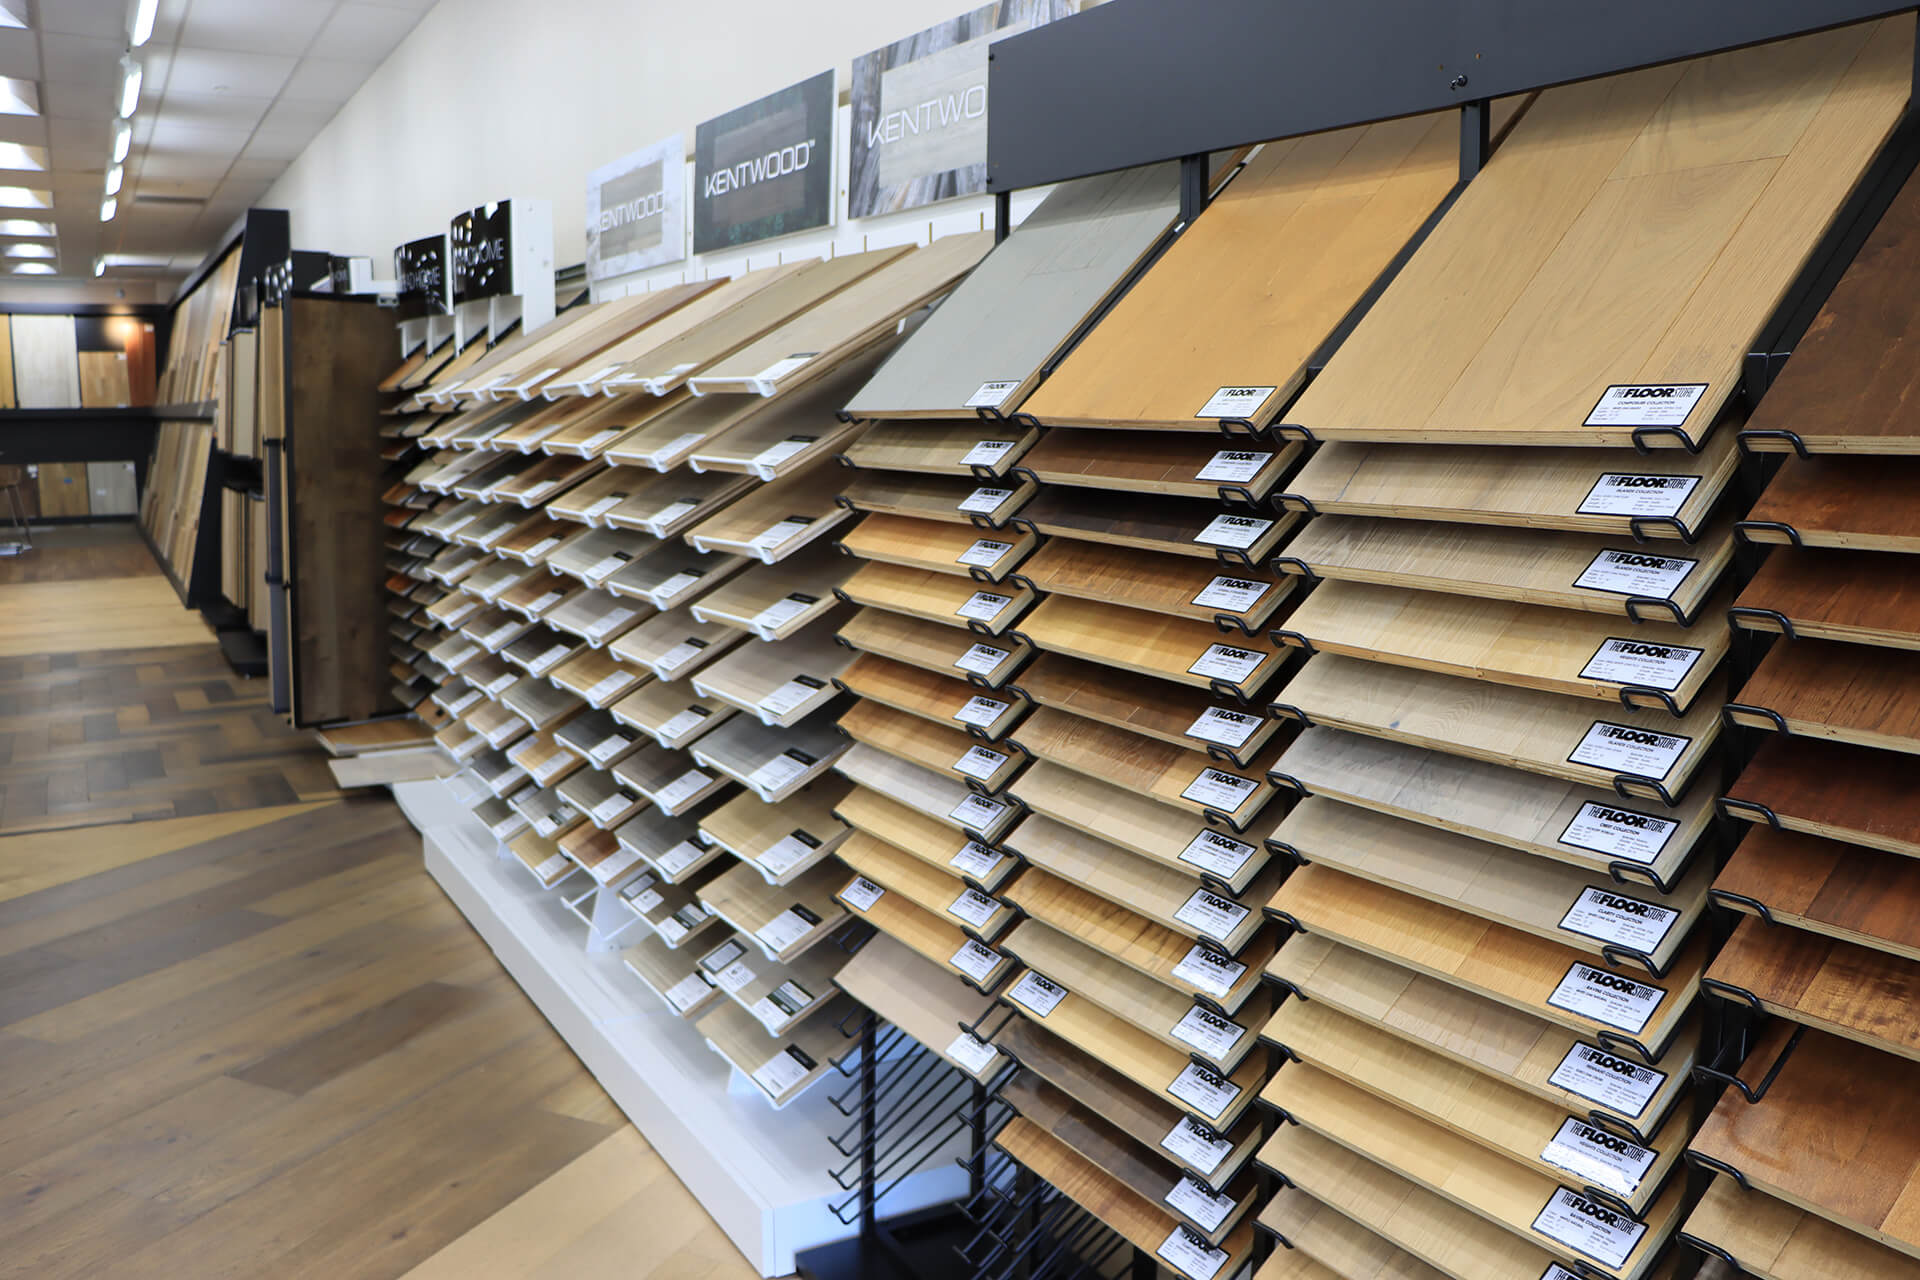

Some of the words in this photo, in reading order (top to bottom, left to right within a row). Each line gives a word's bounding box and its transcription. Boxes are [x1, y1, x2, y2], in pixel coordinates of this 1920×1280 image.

[867, 85, 986, 149] KENTWO
[704, 141, 809, 199] KENTWOOD
[597, 191, 665, 233] ENTWOOD
[1623, 388, 1675, 398] FLOOR
[1616, 476, 1670, 489] FLOOR
[1615, 553, 1667, 569] FLOOR
[1620, 642, 1671, 659] FLOOR
[1608, 727, 1660, 746] FLOOR
[1599, 809, 1649, 828] FLOOR
[1598, 894, 1650, 916] FLOOR
[1587, 970, 1637, 993] FLOOR
[1588, 1051, 1639, 1078] FLOOR
[1580, 1126, 1630, 1154] FLOOR
[1571, 1198, 1620, 1227] FLOOR
